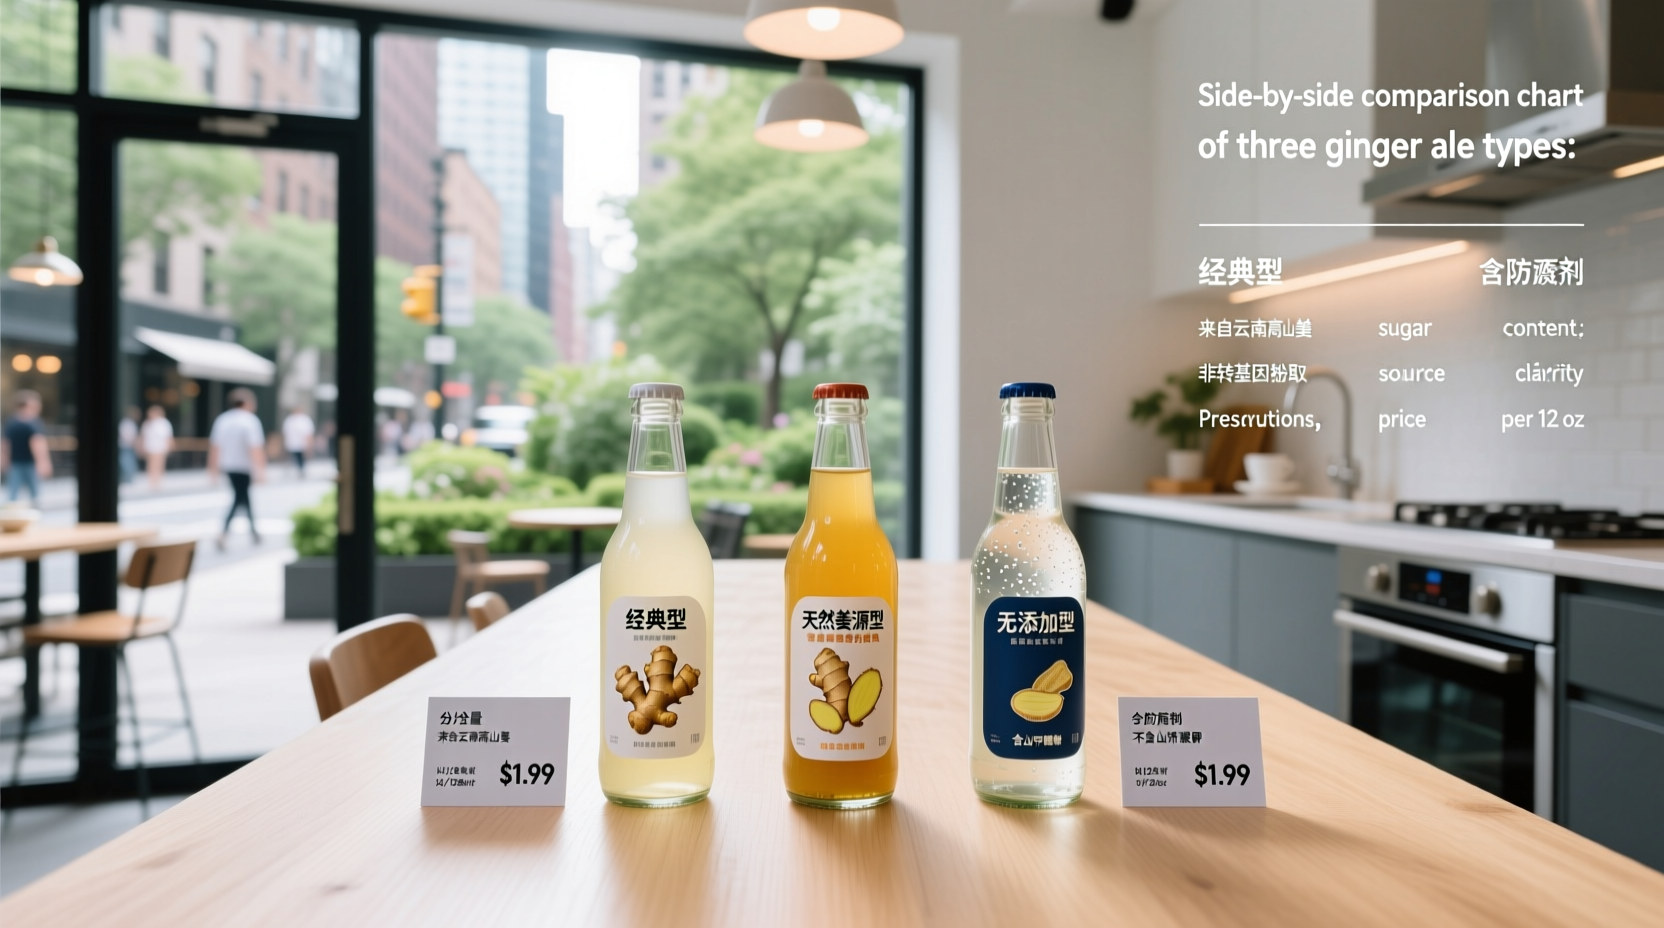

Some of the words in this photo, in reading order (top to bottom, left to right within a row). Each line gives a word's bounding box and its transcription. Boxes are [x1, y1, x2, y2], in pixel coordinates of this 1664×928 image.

[626, 608, 687, 630] 经典型
[997, 611, 1075, 634] 无添加型
[499, 760, 555, 787] $1.99
[1194, 760, 1251, 788] $1.99
